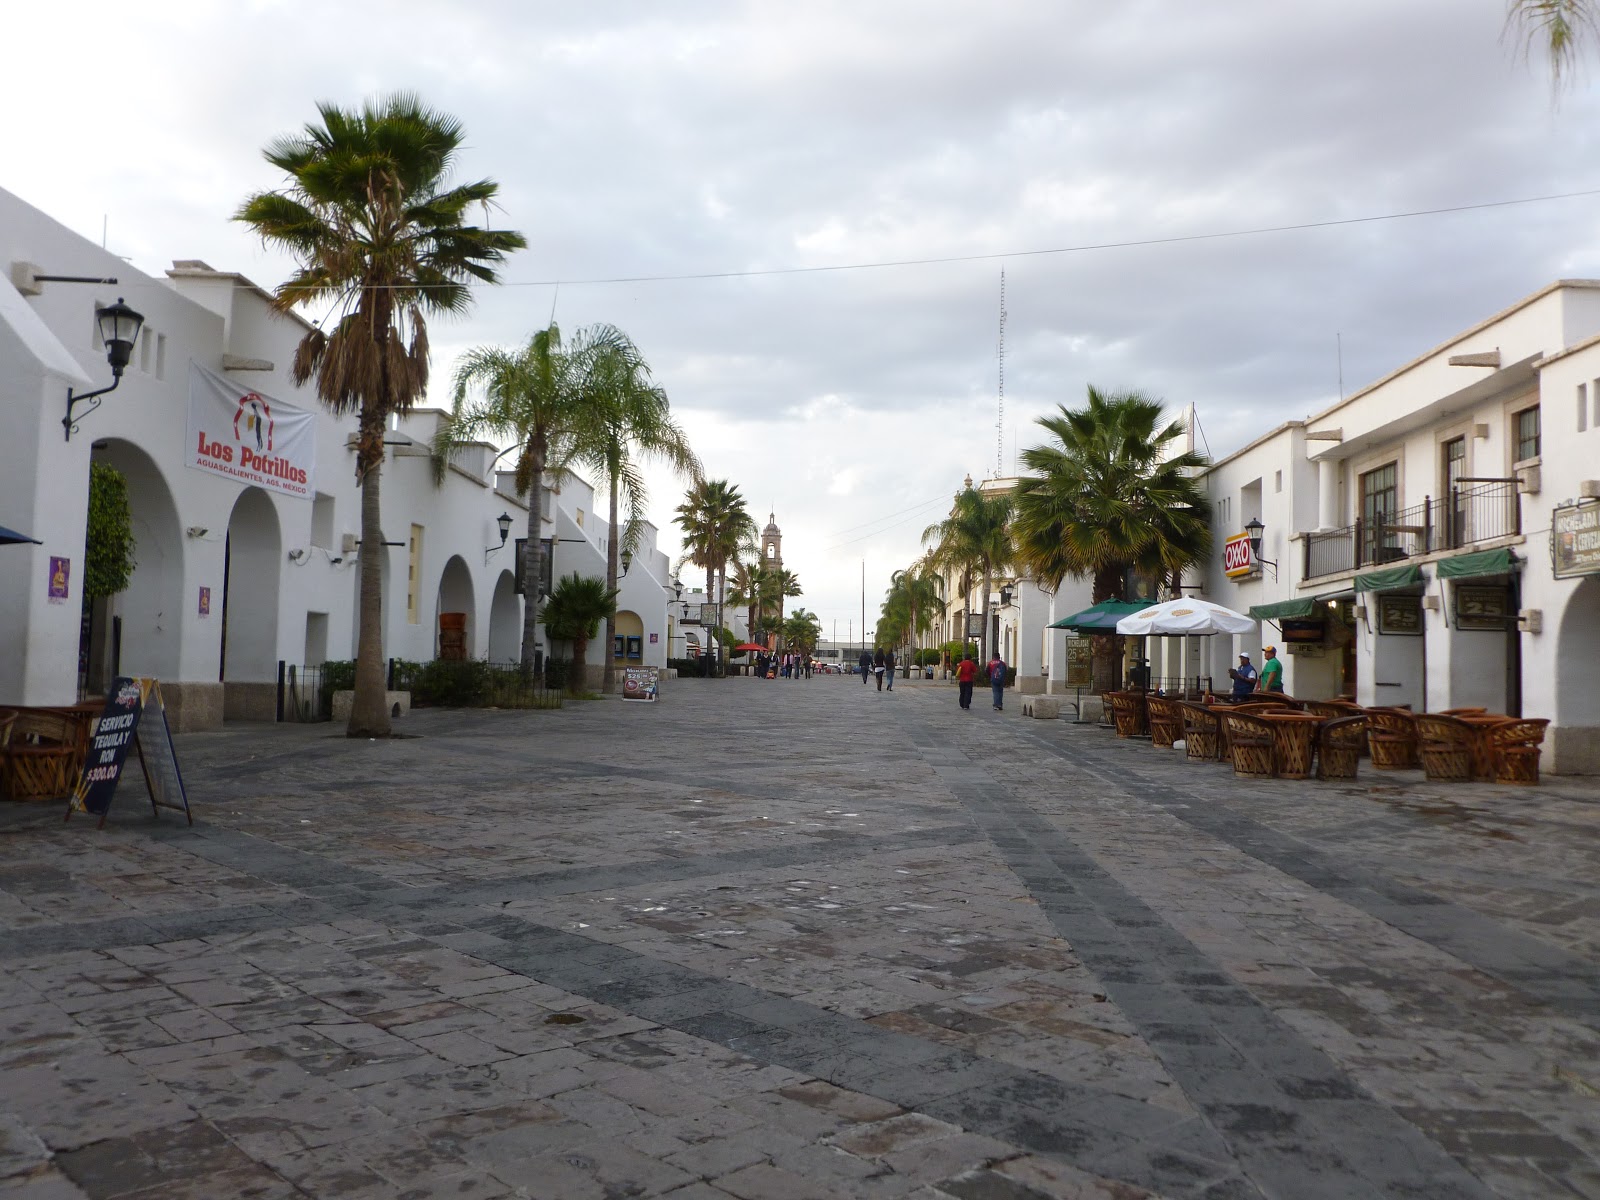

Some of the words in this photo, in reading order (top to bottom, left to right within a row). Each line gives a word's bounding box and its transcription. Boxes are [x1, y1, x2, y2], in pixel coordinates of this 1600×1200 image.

[197, 458, 265, 484] AGUASCALIENTES,
[266, 478, 281, 487] AGS.
[240, 446, 307, 484] Potrillos
[1225, 540, 1249, 569] OXXO
[100, 713, 134, 732] SERVICIO
[94, 733, 123, 749] TEQUILA
[123, 730, 131, 744] Y
[99, 748, 116, 764] RON
[87, 764, 118, 782] $300.00
